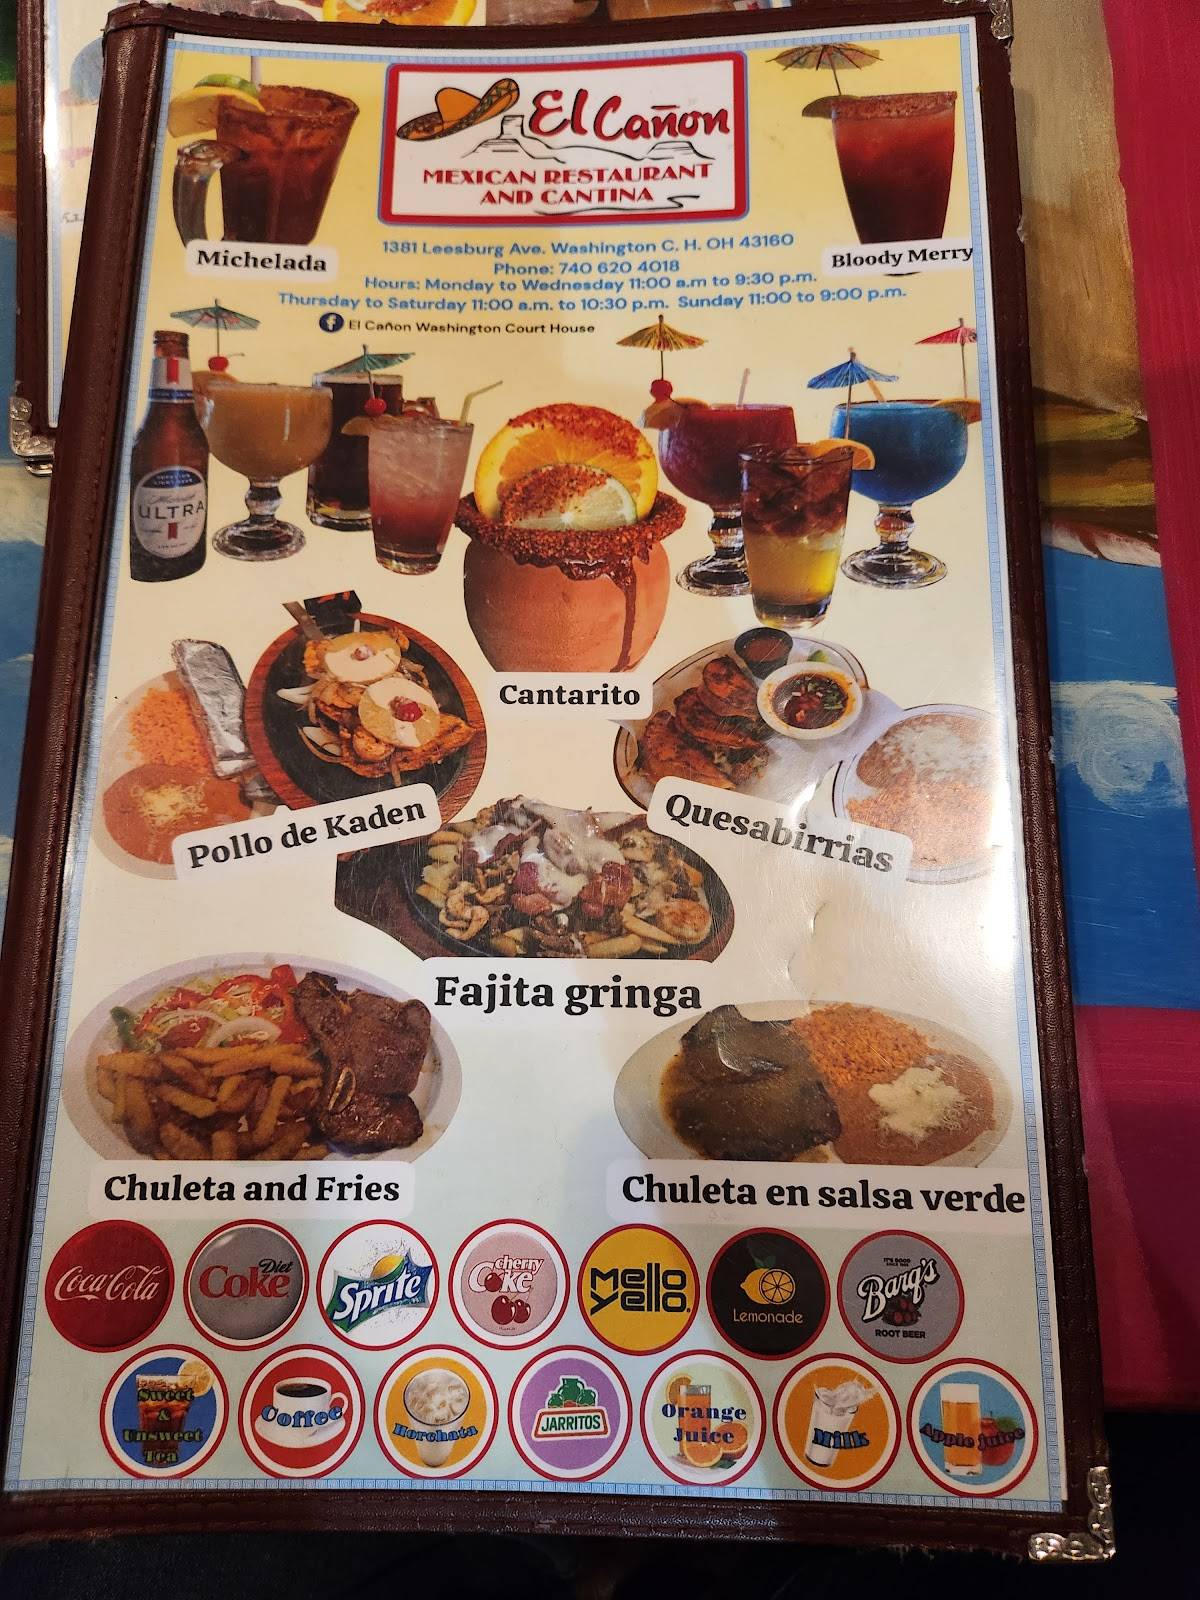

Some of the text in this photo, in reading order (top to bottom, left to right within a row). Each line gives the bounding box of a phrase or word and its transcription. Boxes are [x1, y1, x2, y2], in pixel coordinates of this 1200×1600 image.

[529, 89, 588, 136] El
[423, 163, 713, 185] MEXICAN RESTAURANT
[480, 187, 653, 206] AND CANTINA
[382, 234, 794, 258] 1381 Leesburg Ave. Washington C. H. OH 43160
[832, 247, 973, 267] Bloody Merry
[197, 250, 327, 272] Michelada
[494, 260, 680, 276] Phone: 740 620 4018
[365, 272, 817, 294] Hours: Monday to Wednesday 11:00 a.m to 9:30 p.m.
[278, 287, 907, 313] Thursday to Saturday 11:00 a.m. to 10:30 p.m. Sunday 11:00 to 9:00 p.m.
[349, 319, 595, 335] El Cañon Washington Court House
[138, 501, 205, 519] ULTRA
[499, 683, 640, 706] Cantarito
[187, 801, 426, 868] Pollo de Kaden
[665, 794, 893, 874] Quesabirrias
[434, 973, 702, 1017] Fajita gringa
[104, 1173, 400, 1201] Chuleta and Fries
[622, 1174, 1026, 1214] Chuleta en salsa verde
[258, 1258, 293, 1274] Diet
[494, 1254, 544, 1277] cherry
[200, 1265, 290, 1298] Coke
[857, 1258, 940, 1323] Barq's
[333, 1267, 422, 1322] Sprite
[733, 1308, 803, 1324] Lemonade
[875, 1329, 926, 1339] ROOT BEER
[137, 1388, 195, 1403] Sweet
[261, 1404, 343, 1428] Coffee
[541, 1414, 601, 1433] JARRITOS
[661, 1402, 747, 1424] Orange
[122, 1427, 203, 1443] Unsweet
[393, 1422, 479, 1443] Horchata
[673, 1427, 734, 1445] Juice
[812, 1427, 870, 1450] Milk
[919, 1423, 975, 1448] Apple
[144, 1449, 178, 1462] Tea
